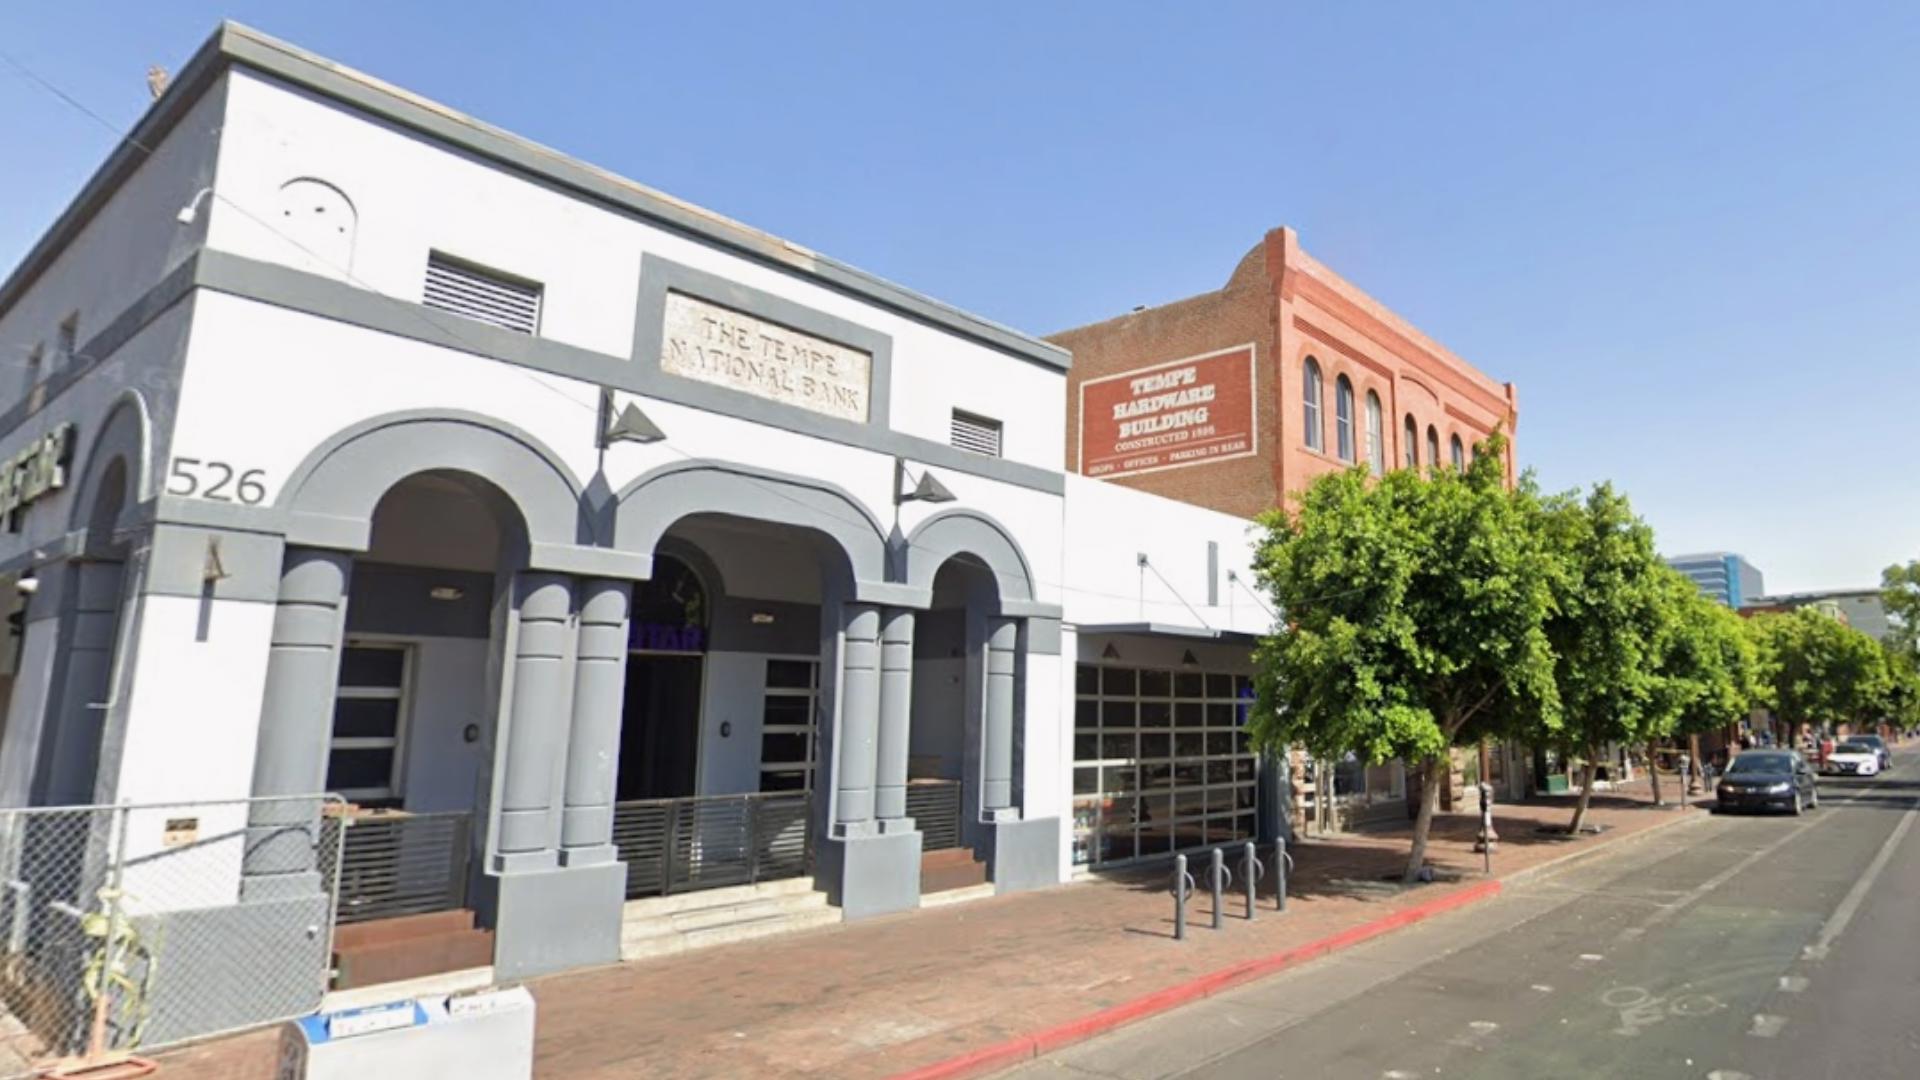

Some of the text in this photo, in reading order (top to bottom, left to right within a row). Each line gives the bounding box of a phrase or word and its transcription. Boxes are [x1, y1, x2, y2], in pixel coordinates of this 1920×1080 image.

[702, 316, 838, 377] THE TEMPE
[669, 337, 860, 411] NATIONAL BANK
[1130, 366, 1197, 395] TEMPE
[1112, 384, 1216, 420] HARDWARE
[1118, 406, 1209, 438] BUILDING
[1114, 431, 1188, 452] CONSTRUCTED
[1169, 446, 1208, 461] PARKING
[167, 456, 265, 504] 526
